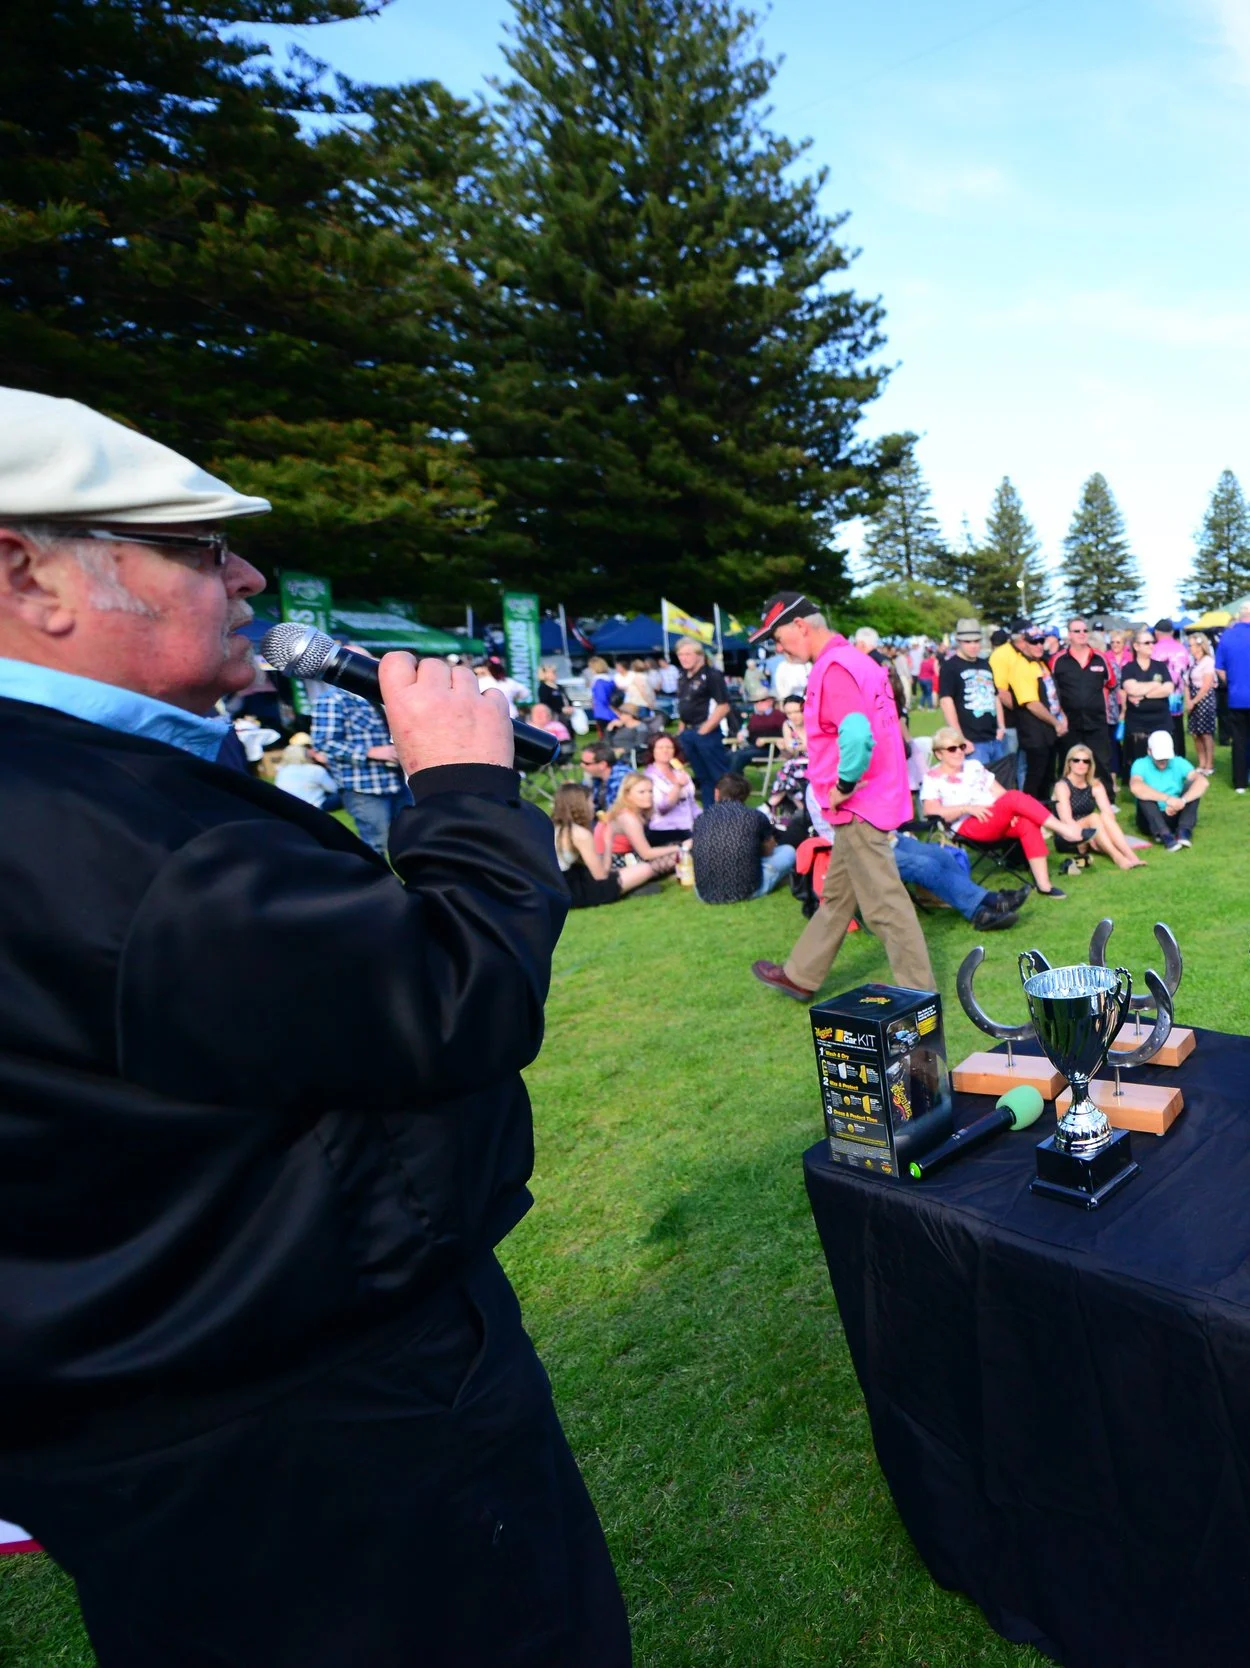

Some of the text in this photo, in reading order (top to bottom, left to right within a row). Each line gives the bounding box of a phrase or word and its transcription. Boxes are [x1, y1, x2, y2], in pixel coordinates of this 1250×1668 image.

[843, 1035, 857, 1045] Car
[857, 1033, 876, 1047] KIT
[820, 1047, 824, 1056] 1
[823, 1076, 829, 1086] 2
[827, 1105, 833, 1115] 3
